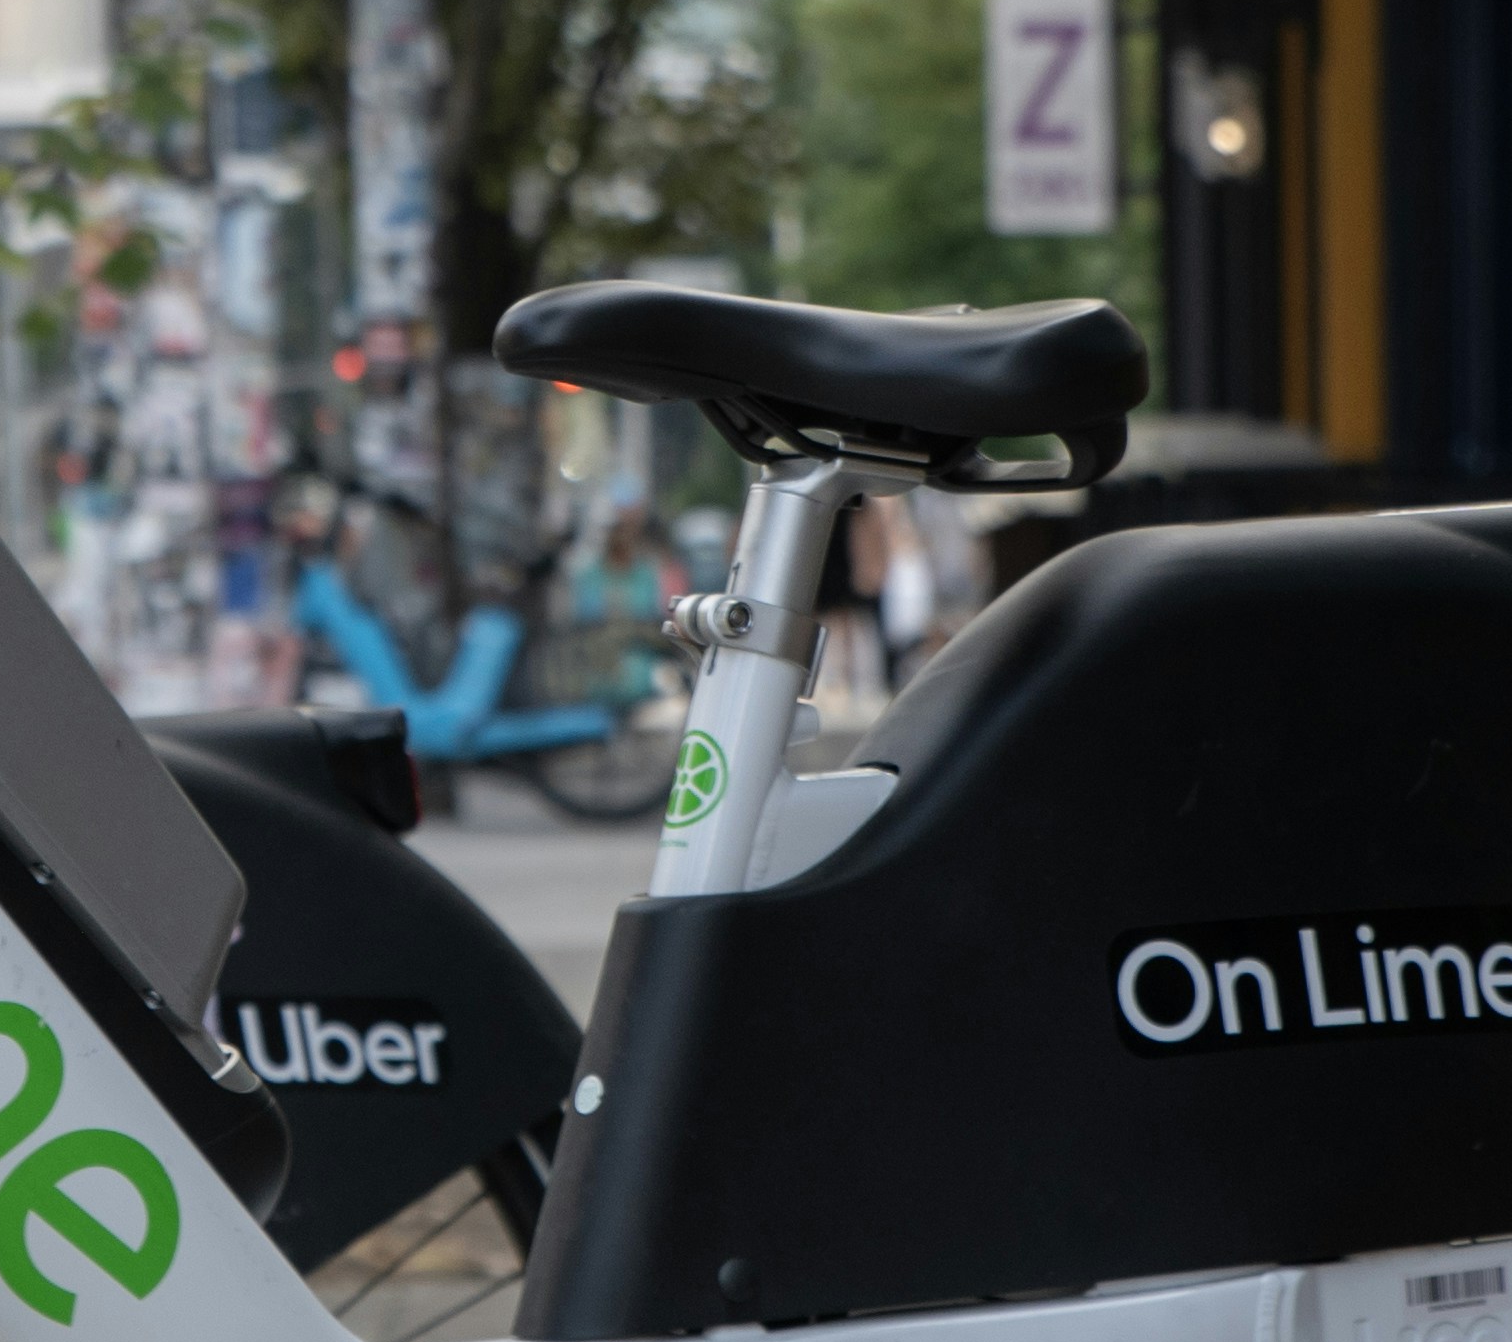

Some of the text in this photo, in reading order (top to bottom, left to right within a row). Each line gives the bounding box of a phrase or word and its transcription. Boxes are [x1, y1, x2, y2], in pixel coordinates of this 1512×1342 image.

[1016, 18, 1085, 146] Z
[1118, 939, 1282, 1042] On
[238, 1001, 446, 1086] Uber
